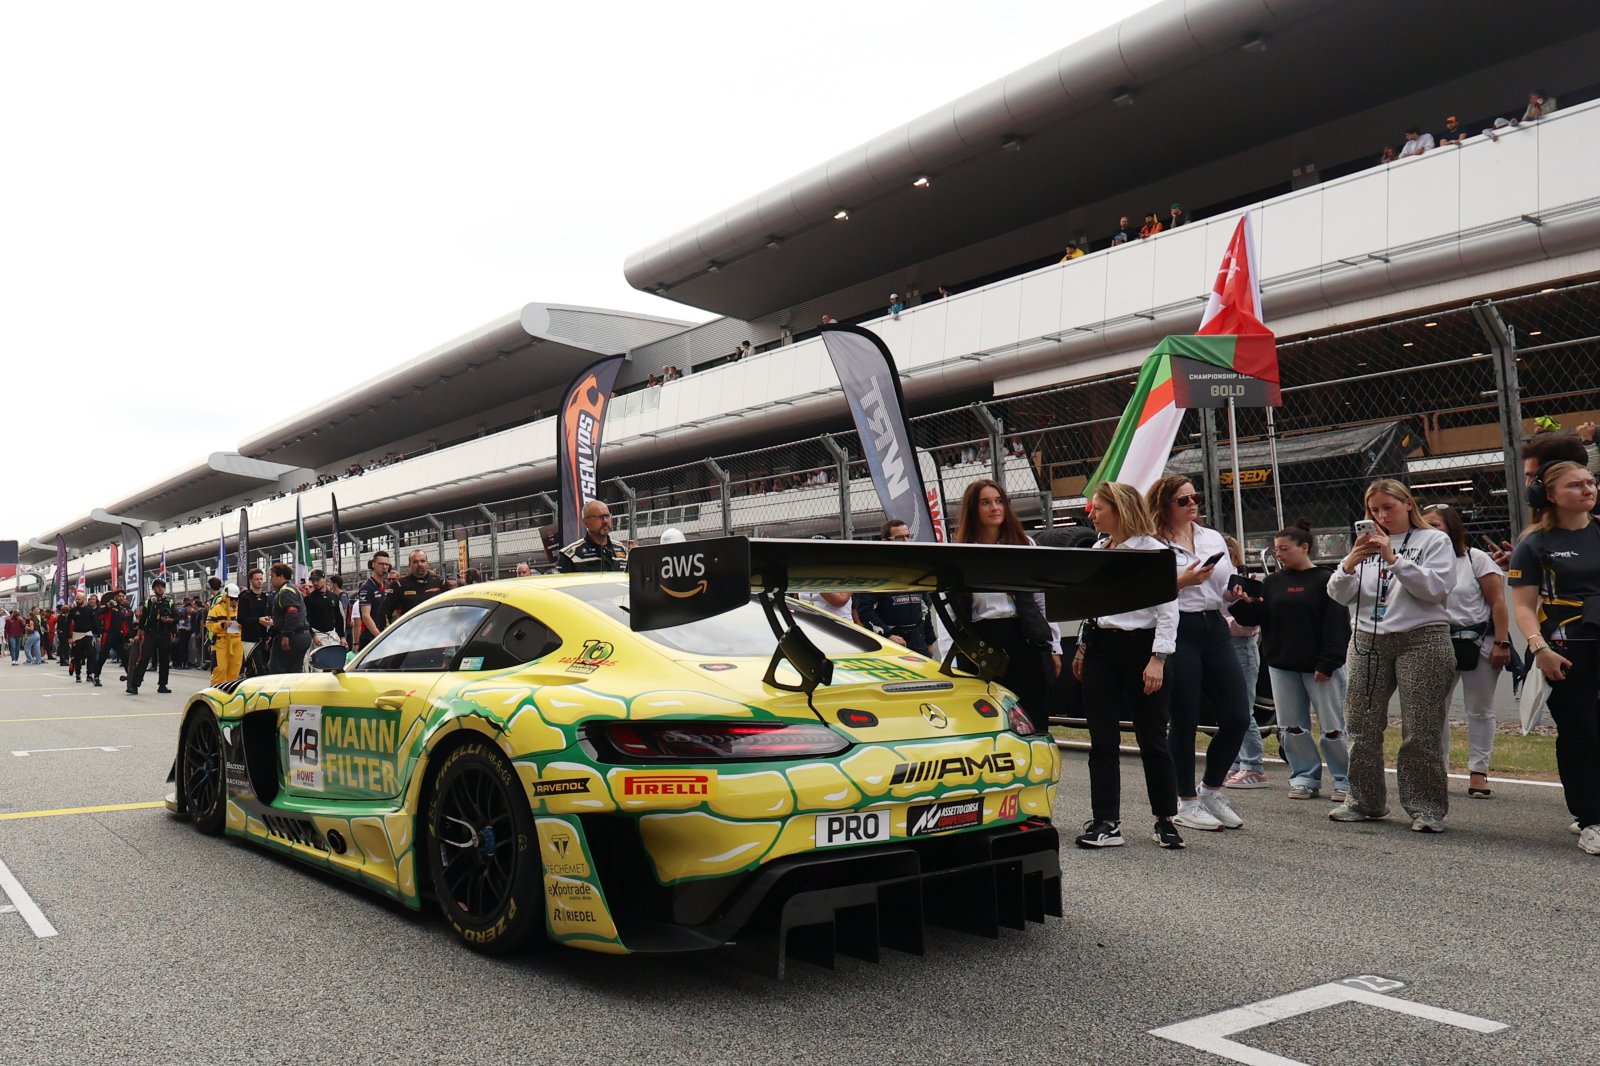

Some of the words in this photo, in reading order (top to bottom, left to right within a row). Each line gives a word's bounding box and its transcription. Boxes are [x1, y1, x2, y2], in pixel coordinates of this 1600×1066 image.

[1210, 384, 1245, 397] GOLD
[661, 553, 705, 579] aws
[289, 727, 319, 766] 48
[325, 716, 396, 753] MANN
[297, 769, 314, 782] ROWE
[326, 753, 397, 796] FILTER
[938, 752, 1016, 780] AMG
[536, 782, 585, 794] RAVENOL
[624, 775, 709, 795] PIRELLI
[998, 794, 1019, 821] 48
[827, 813, 879, 843] PRO
[546, 863, 585, 875] TECHEMET
[567, 910, 596, 922] RIEDEL
